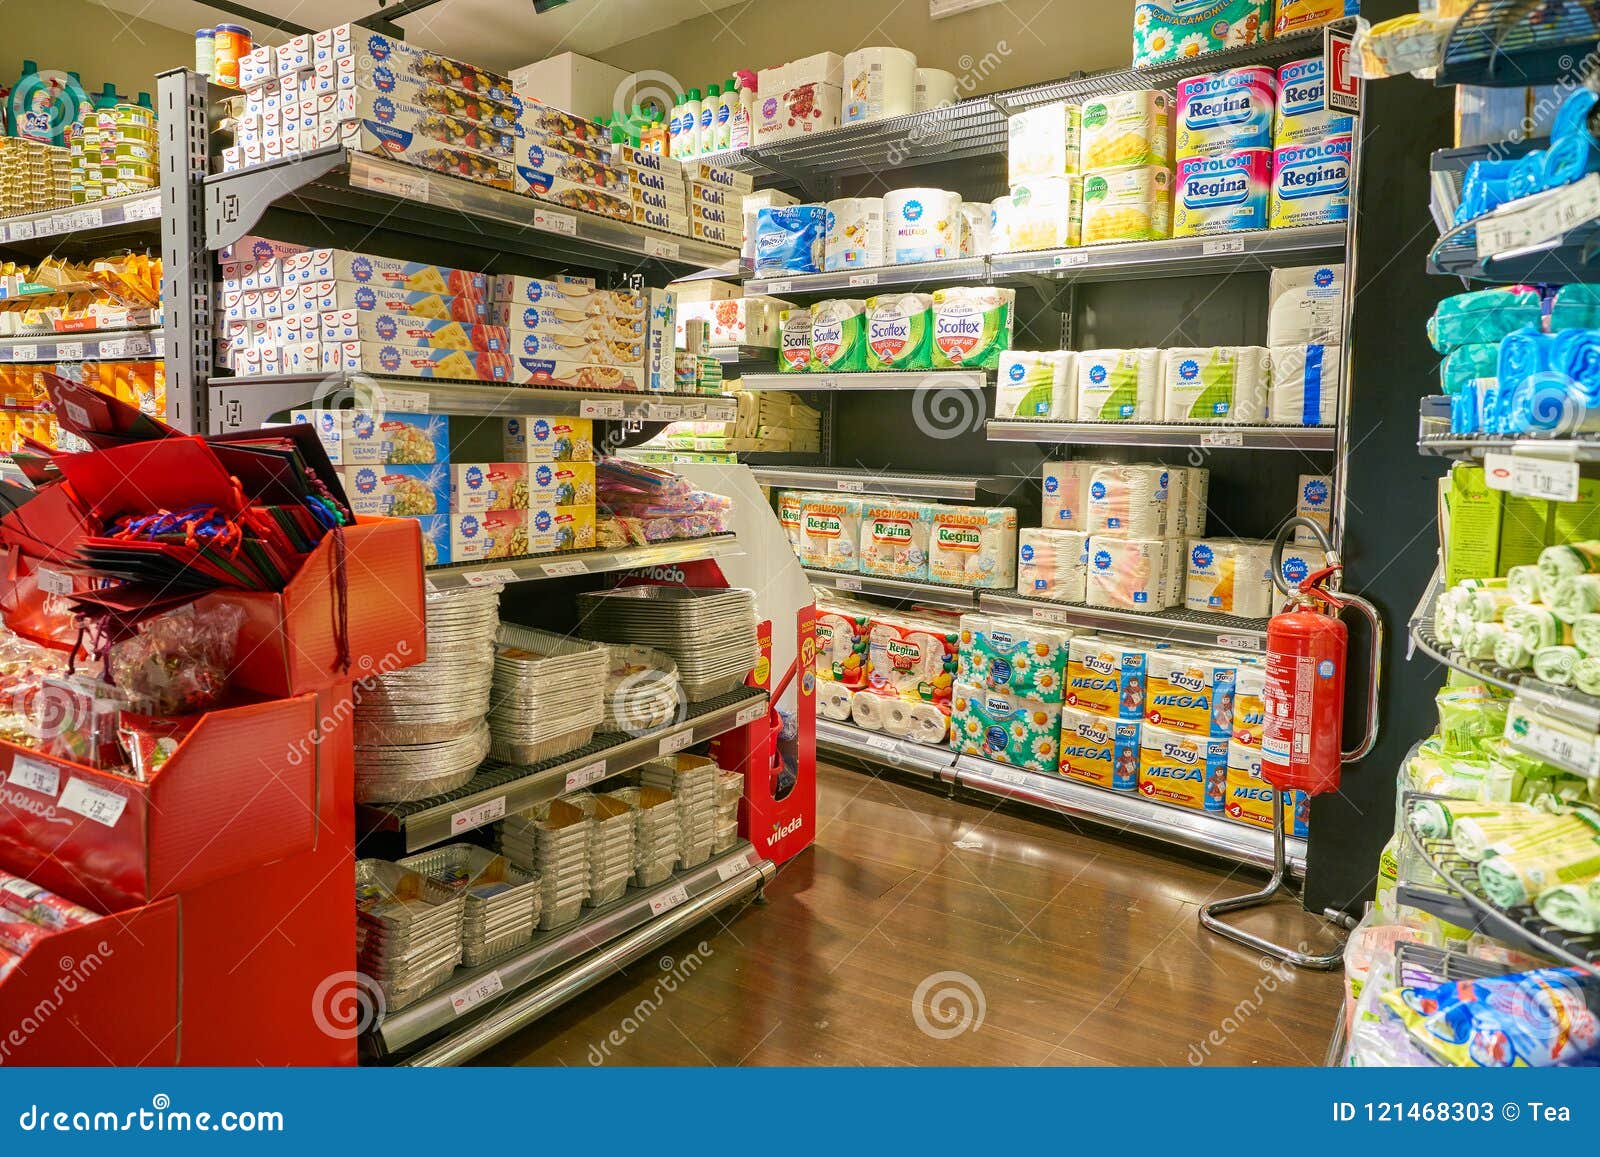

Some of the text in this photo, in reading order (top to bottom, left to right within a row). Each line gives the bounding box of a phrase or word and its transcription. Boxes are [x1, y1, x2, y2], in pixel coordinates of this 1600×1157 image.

[1281, 60, 1324, 80] ROTOL
[1185, 74, 1254, 95] ROTOLONI
[1284, 80, 1324, 104] Regi
[1188, 94, 1251, 118] Regina
[1332, 92, 1358, 109] ESTINTORE
[27, 116, 46, 129] ACE
[633, 151, 661, 170] Cuki
[1278, 142, 1352, 163] ROTOLONI
[1183, 156, 1250, 174] ROTOLONI
[638, 173, 665, 191] Cuki
[709, 169, 734, 187] Cuki
[1282, 165, 1347, 188] Regina
[1187, 177, 1247, 197] Regina
[642, 192, 667, 210] Cuki
[701, 189, 725, 206] Cuki
[645, 210, 670, 228] Cuki
[702, 207, 725, 223] Cuki
[702, 224, 726, 241] Cuki
[571, 277, 588, 285] Cuki
[871, 323, 907, 339] Scottex
[937, 317, 980, 334] Scottex
[783, 334, 810, 347] Scotte
[813, 328, 840, 343] Scottex
[651, 329, 663, 371] Cuki
[802, 503, 847, 514] ASCIUGONI
[868, 508, 919, 520] ASCIUGONI
[807, 516, 840, 532] Regina
[934, 513, 988, 526] ASCIUGONI
[874, 522, 911, 537] Regina
[939, 529, 979, 544] Regina
[1285, 562, 1305, 572] Casa
[816, 627, 833, 637] gina
[991, 633, 1012, 644] Regina
[888, 640, 920, 657] Regina
[1085, 655, 1112, 673] Foxy
[1070, 677, 1119, 693] MEGA
[1170, 671, 1202, 689] Foxy
[988, 700, 1009, 711] Regina
[1068, 695, 1076, 704] 4
[1153, 695, 1209, 710] MEGA
[1150, 712, 1159, 722] 4
[1243, 713, 1264, 725] ME
[1078, 724, 1106, 742] Foxy
[1240, 733, 1250, 743] 4
[1064, 746, 1112, 761] MEGA
[1164, 743, 1196, 761] Foxy
[1062, 762, 1070, 771] 4
[1147, 766, 1203, 782] MEGA
[1144, 783, 1154, 793] 4
[1231, 806, 1241, 816] 4
[766, 814, 803, 848] vileda
